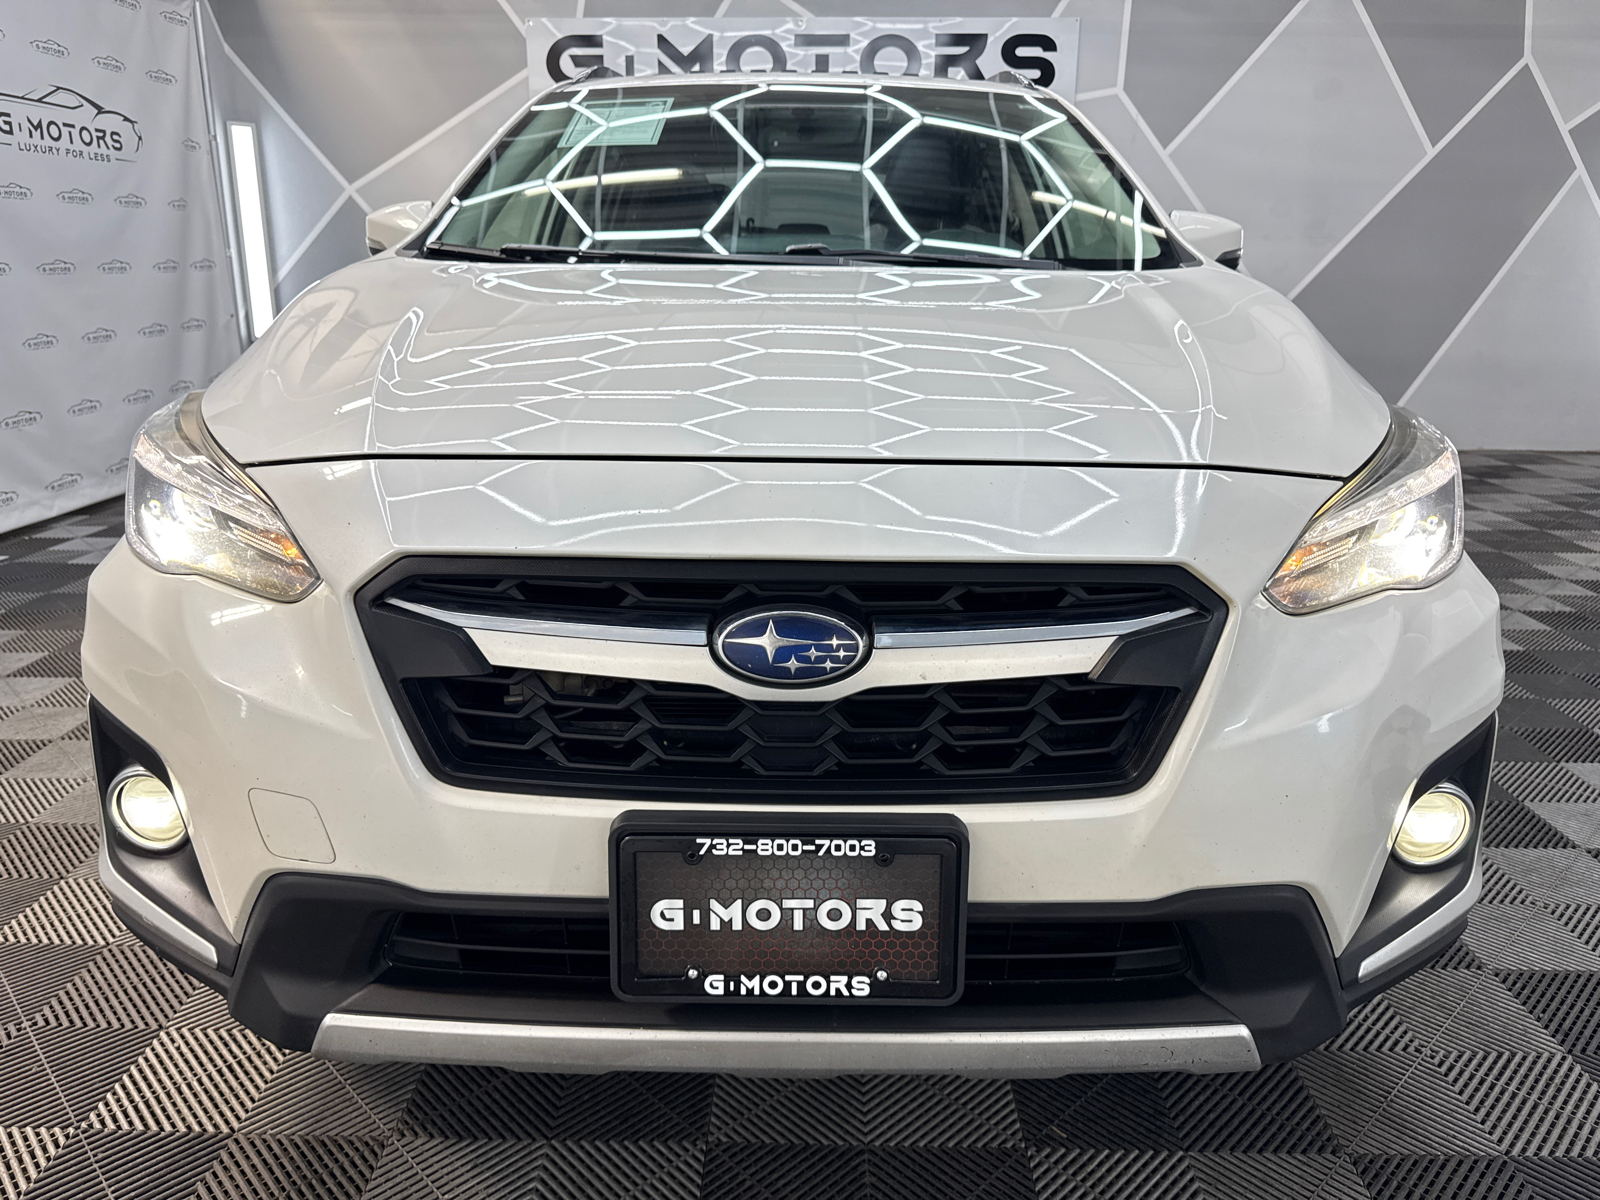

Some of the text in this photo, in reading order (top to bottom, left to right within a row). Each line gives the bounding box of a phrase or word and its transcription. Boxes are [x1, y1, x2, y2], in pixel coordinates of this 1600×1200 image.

[18, 142, 111, 163] LUXURY FOR LESS
[695, 838, 876, 856] 732-800-7003
